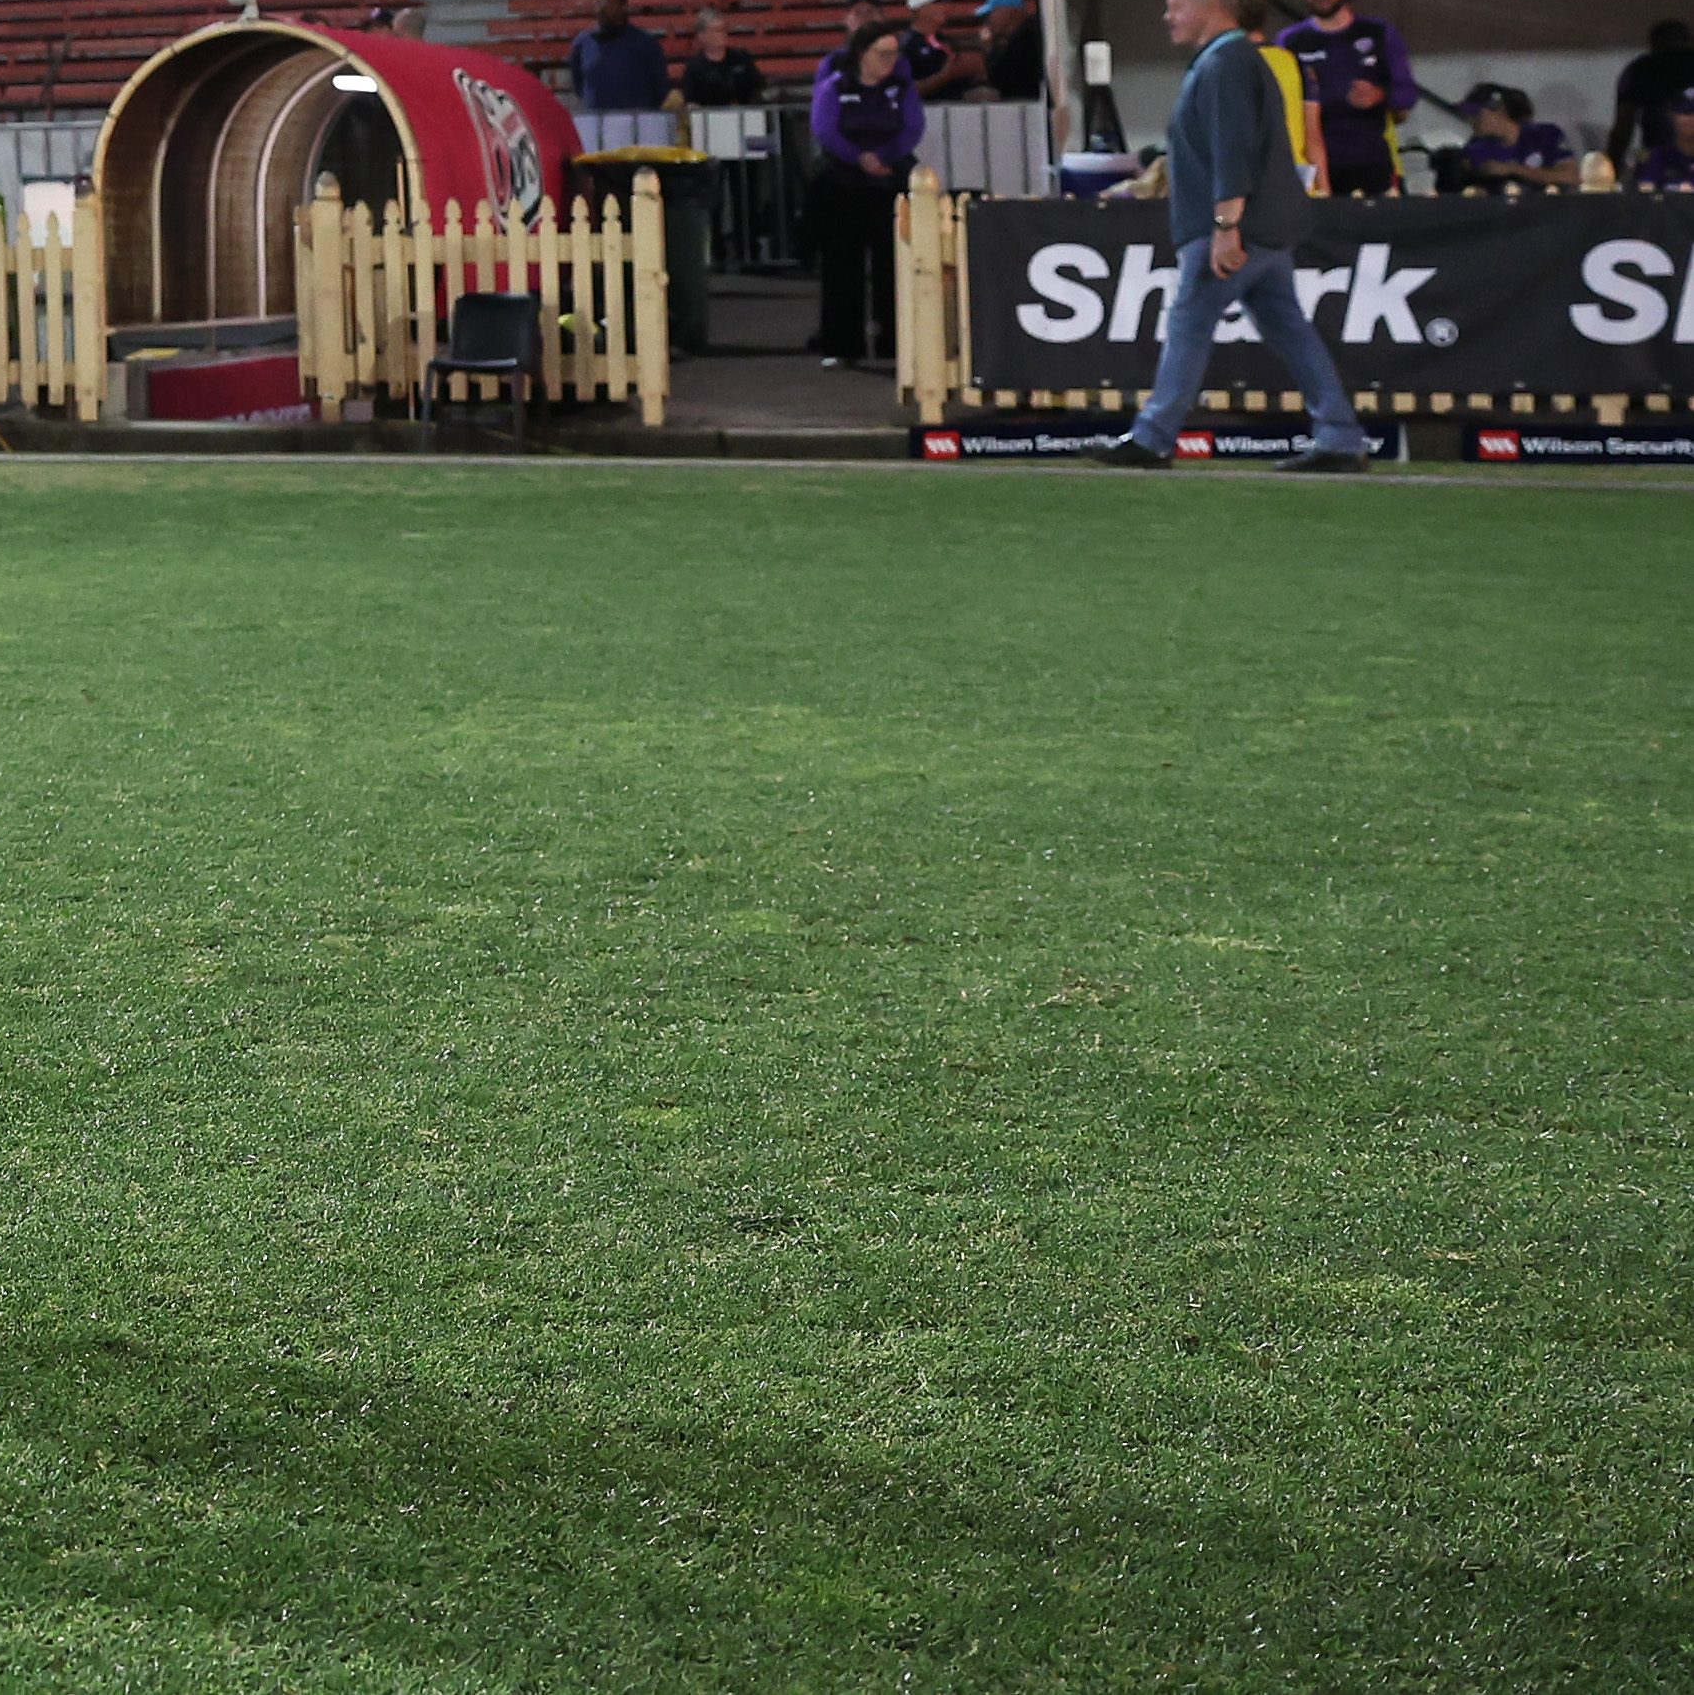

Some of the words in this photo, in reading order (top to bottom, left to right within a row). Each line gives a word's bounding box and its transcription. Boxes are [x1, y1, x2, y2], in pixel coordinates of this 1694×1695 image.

[961, 436, 1033, 454] Wilson
[1214, 436, 1290, 453] Wilson
[1521, 436, 1603, 455] Wilson
